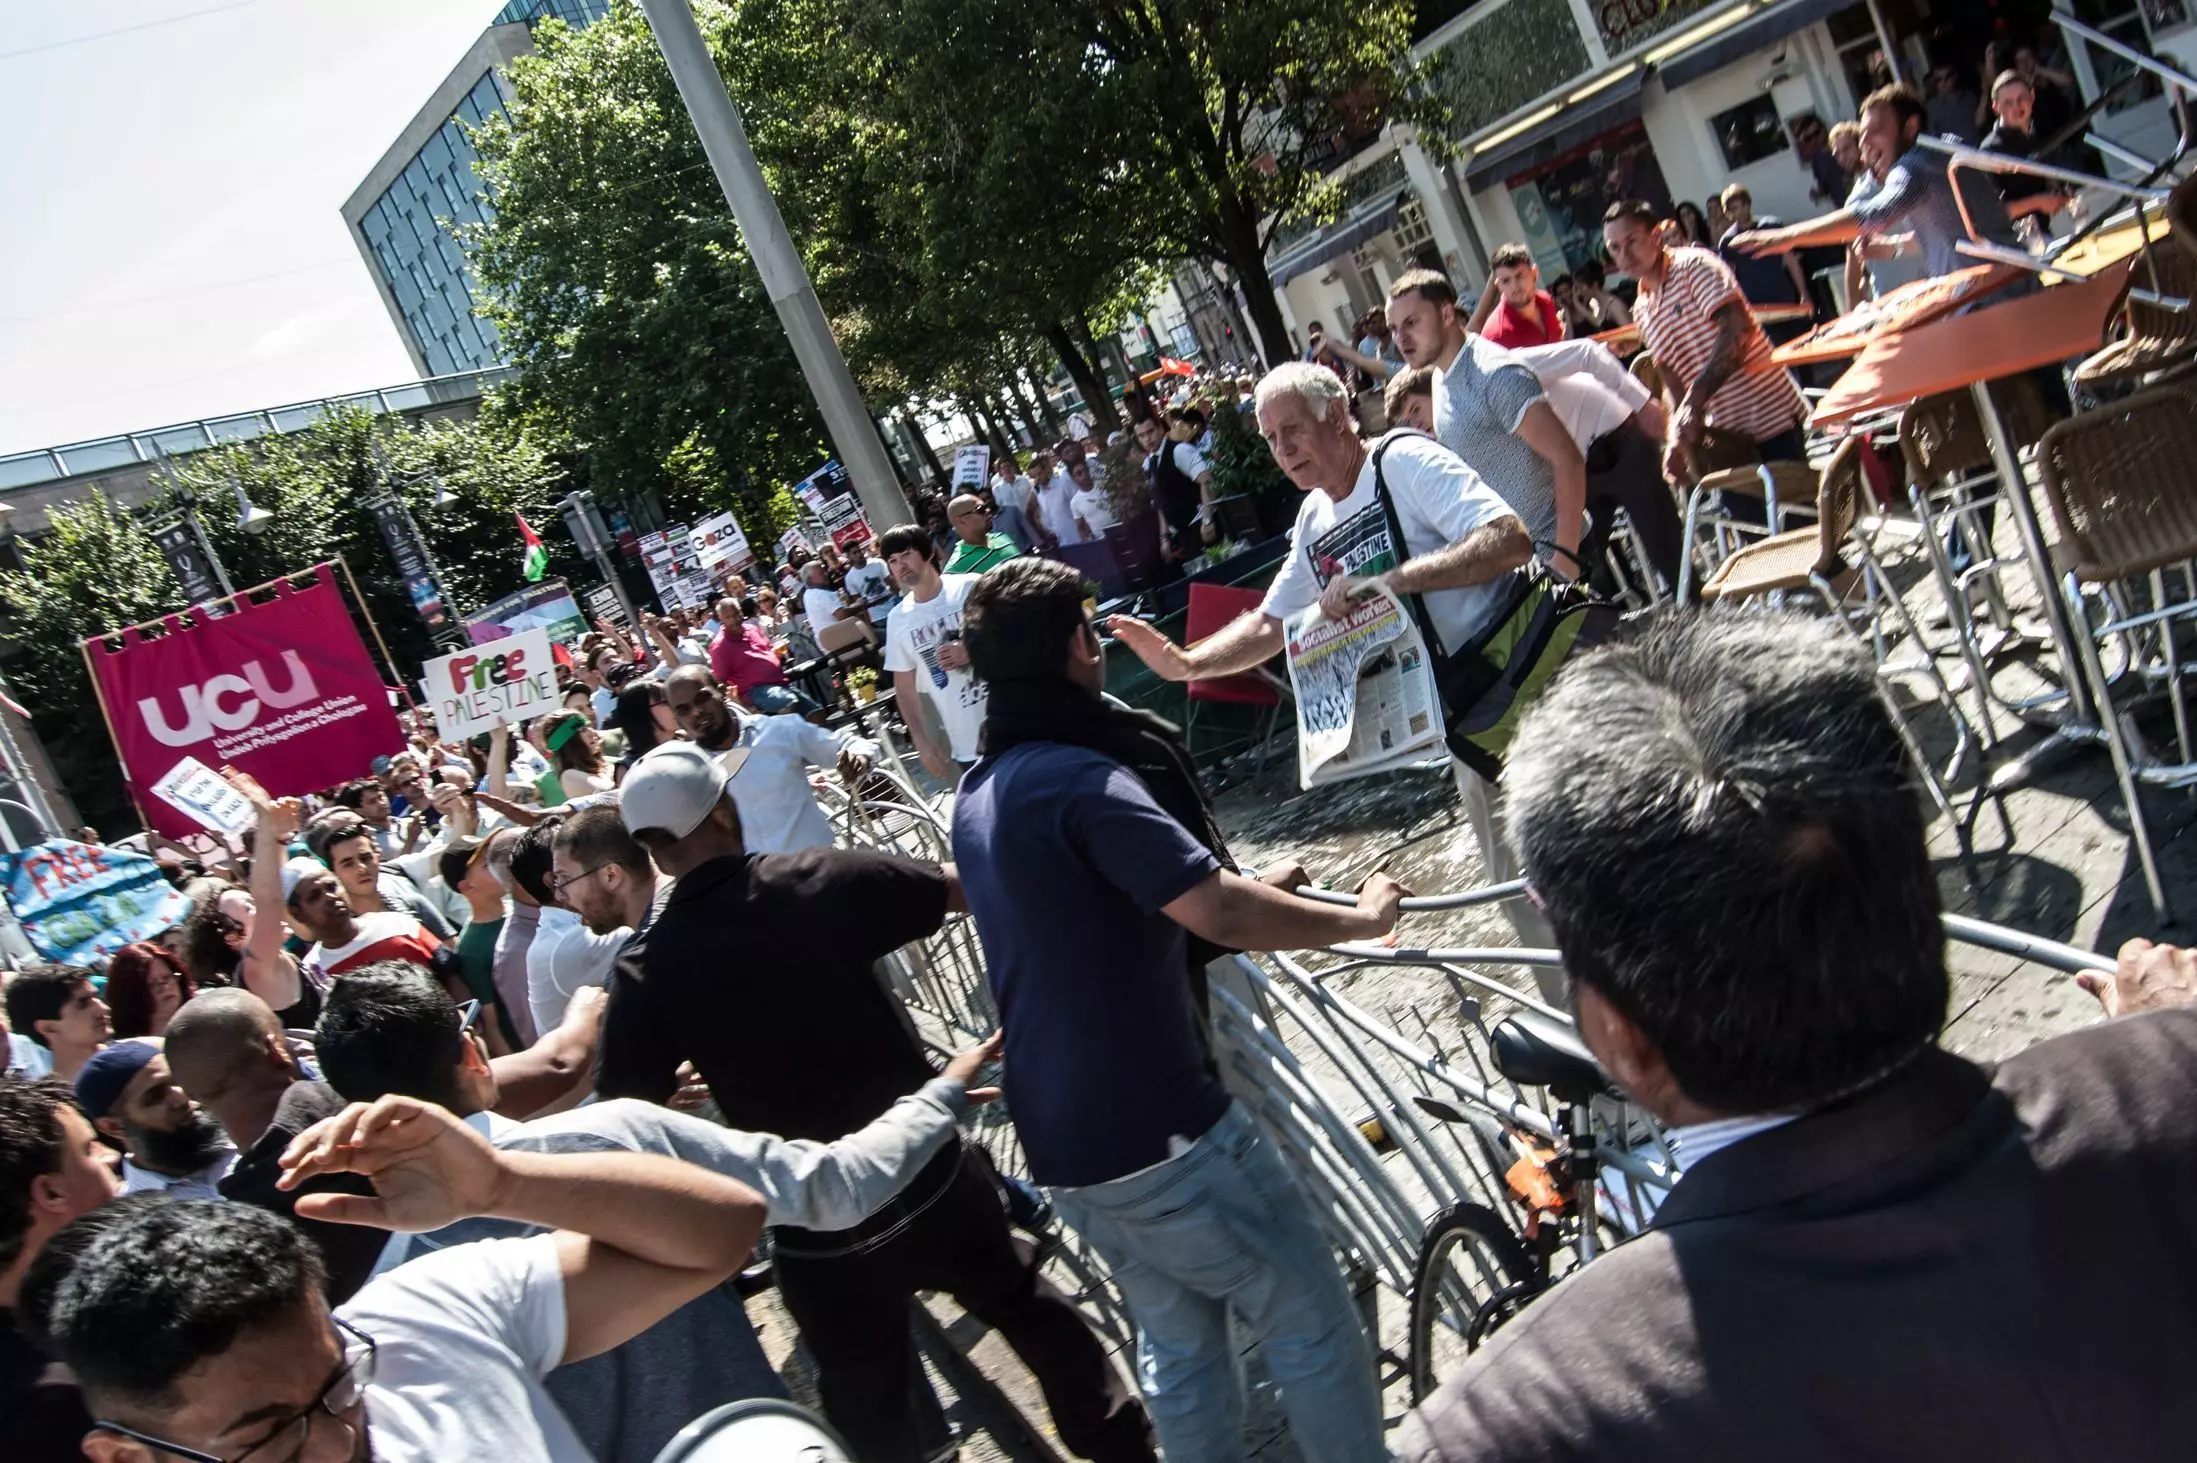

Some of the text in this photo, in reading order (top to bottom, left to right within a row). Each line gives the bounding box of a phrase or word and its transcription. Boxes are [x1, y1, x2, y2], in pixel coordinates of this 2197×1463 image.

[589, 588, 614, 606] END
[1350, 598, 1391, 627] Worker
[448, 648, 528, 695] Free
[213, 695, 357, 749] University and College Union
[442, 671, 553, 727] PALESTINE
[24, 845, 112, 900] FREE
